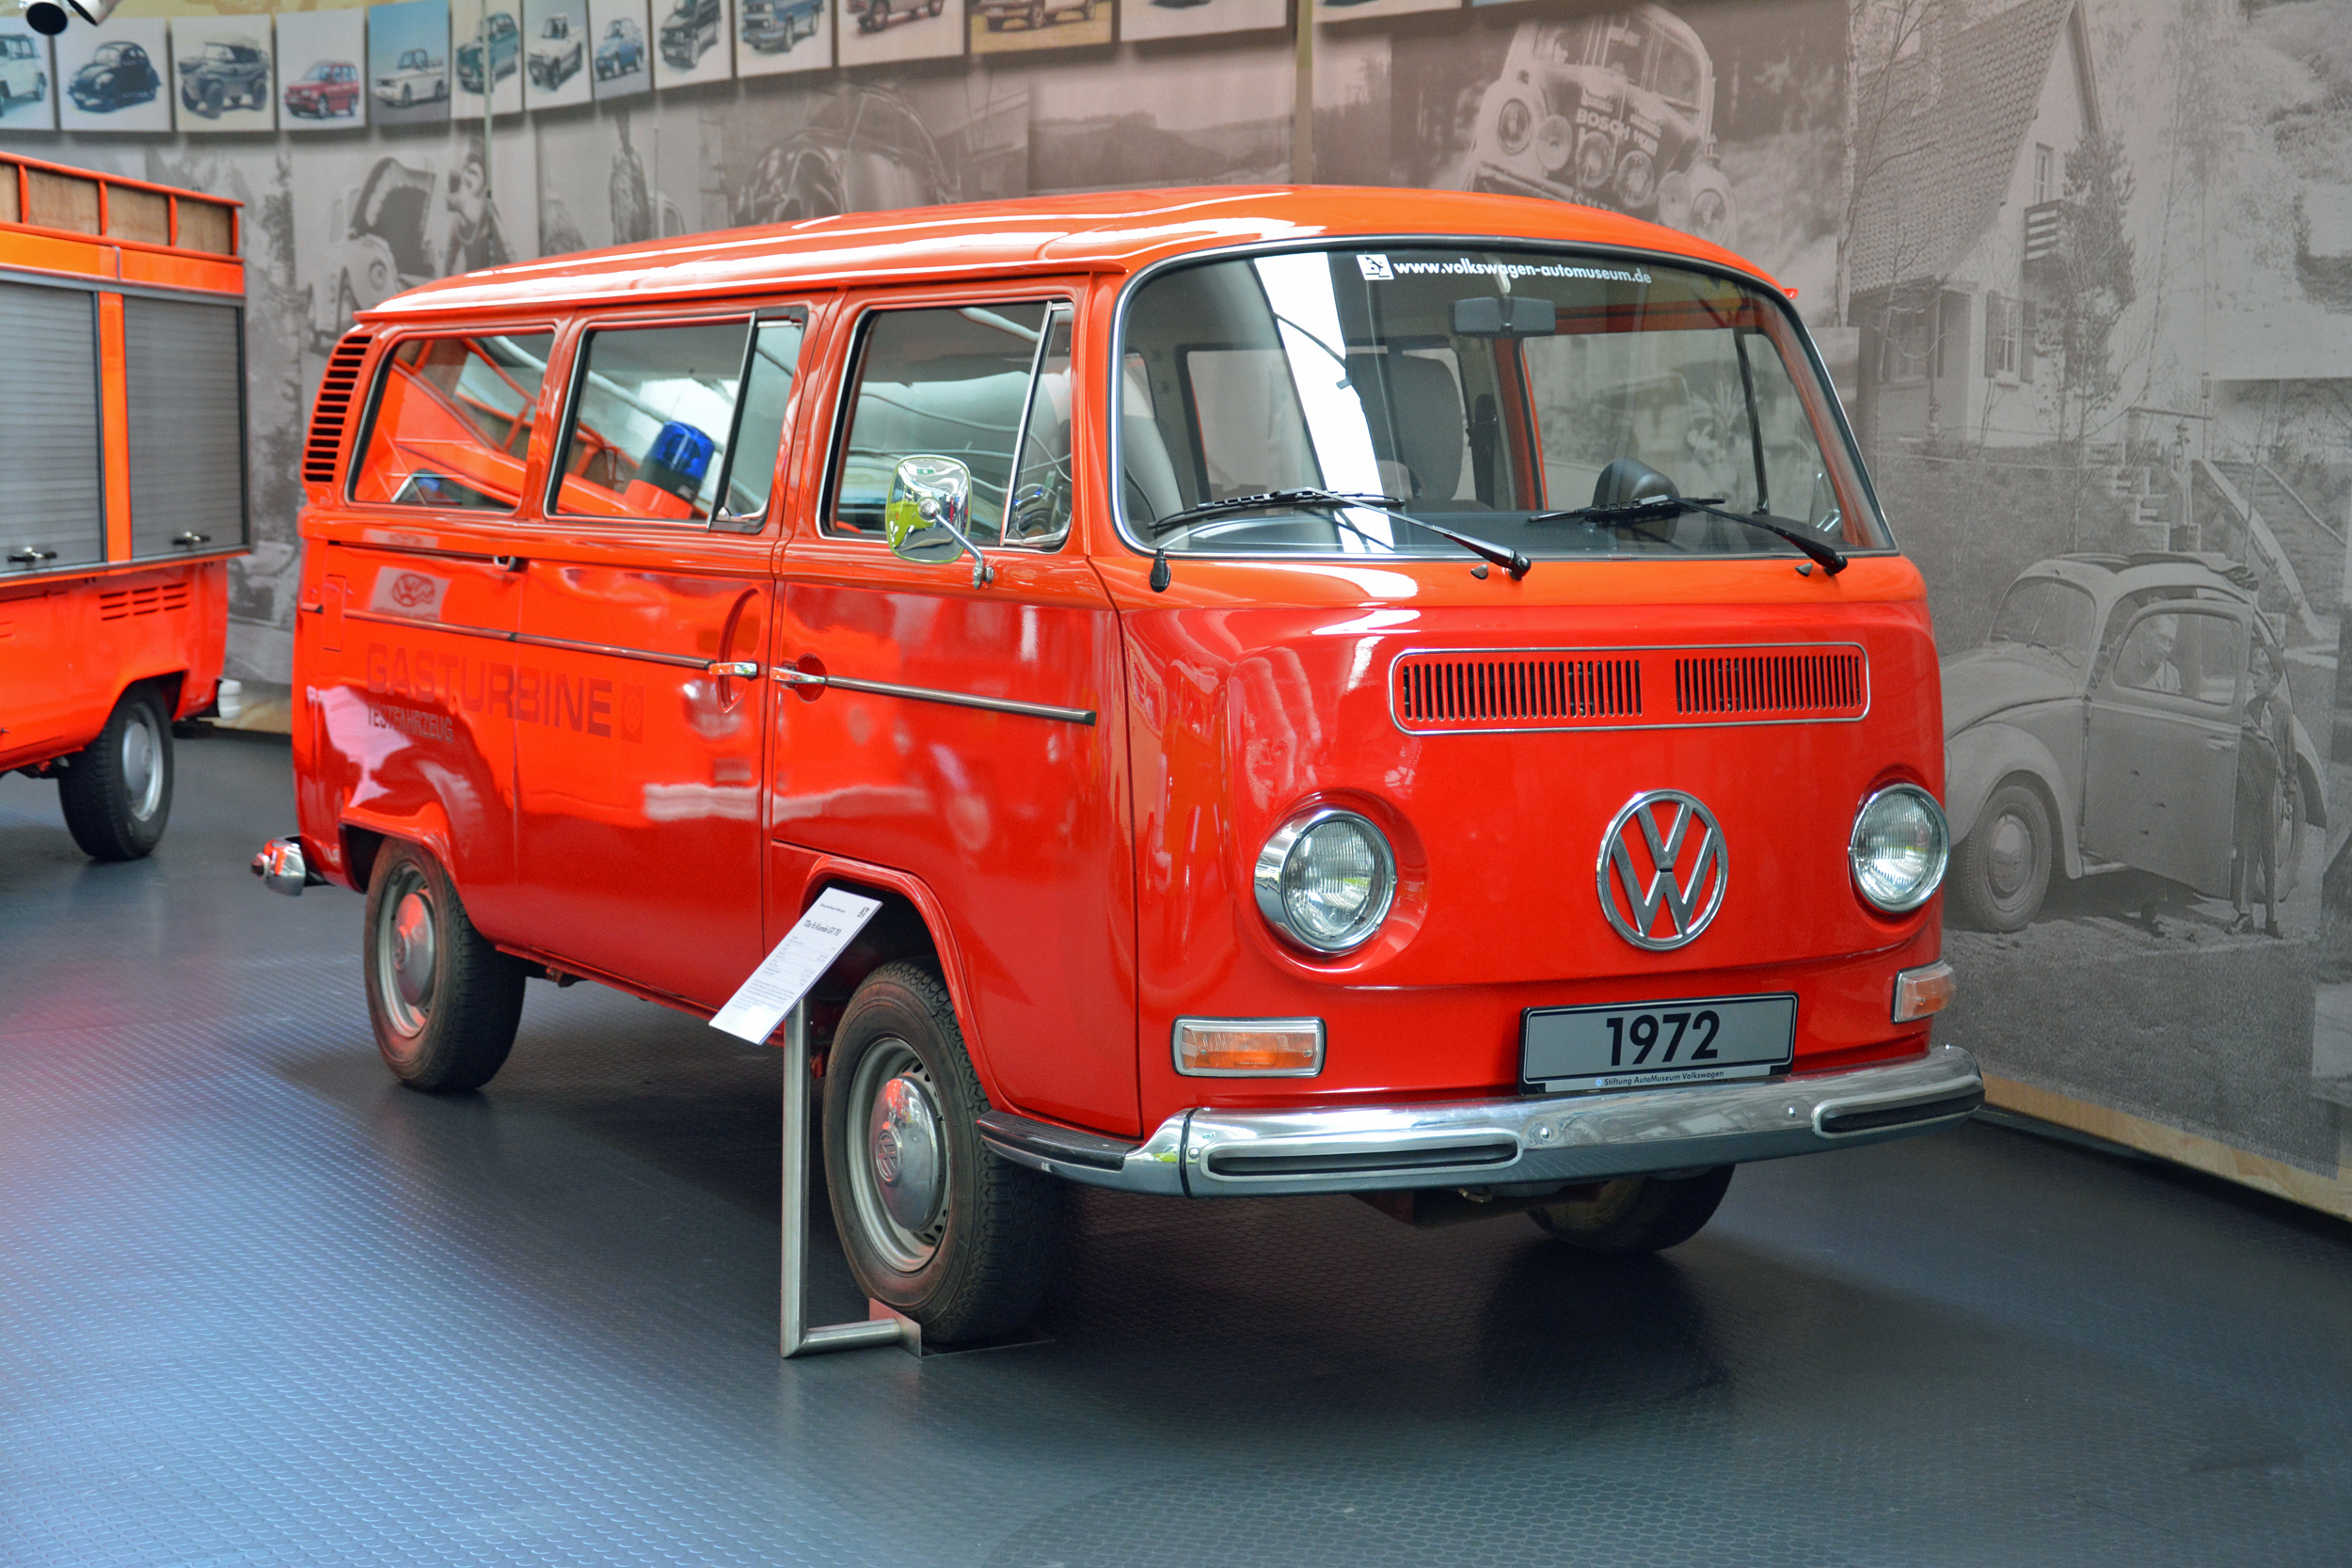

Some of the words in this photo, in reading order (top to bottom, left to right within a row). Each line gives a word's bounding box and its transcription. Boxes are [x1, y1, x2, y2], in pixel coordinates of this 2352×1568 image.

[1392, 258, 1652, 284] www.volkswagen-automuseum.de
[366, 641, 613, 738] GASTURBINE
[367, 703, 453, 743] TESTFAHRZEUG
[1597, 788, 1729, 952] VW
[1606, 1010, 1721, 1067] 1972
[1604, 1076, 1632, 1086] Stiftung
[1634, 1073, 1680, 1084] AutoMuseum
[1682, 1069, 1724, 1082] Volkswagen
